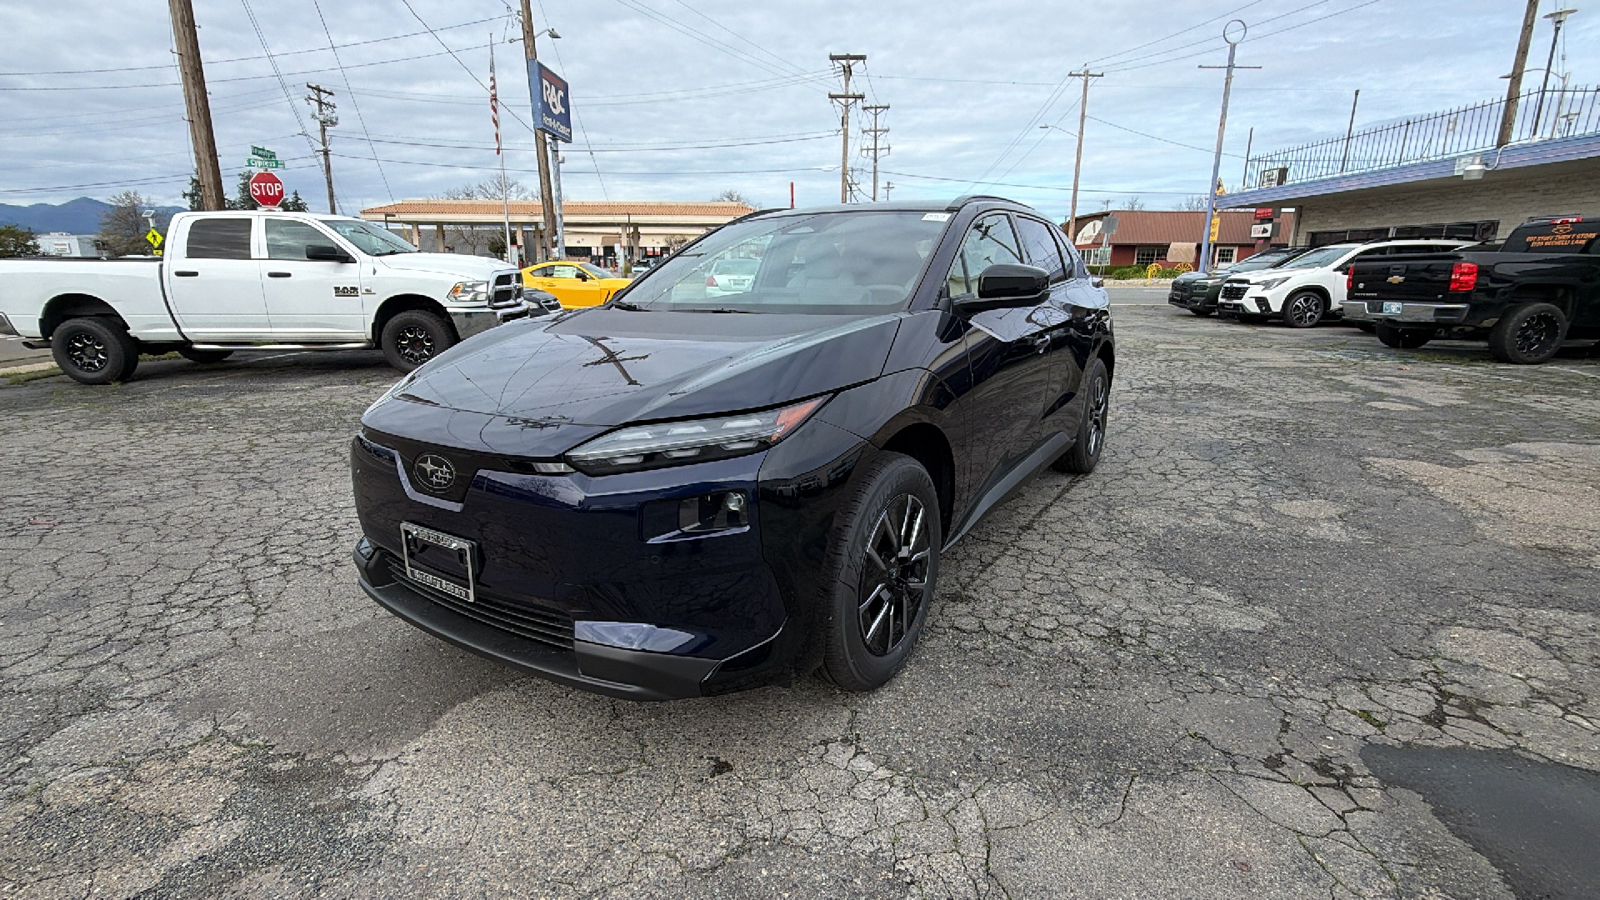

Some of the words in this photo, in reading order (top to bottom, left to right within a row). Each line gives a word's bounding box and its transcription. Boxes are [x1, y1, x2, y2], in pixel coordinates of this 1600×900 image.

[542, 78, 565, 115] RAC
[251, 160, 276, 168] Cypress
[252, 183, 283, 196] STOP
